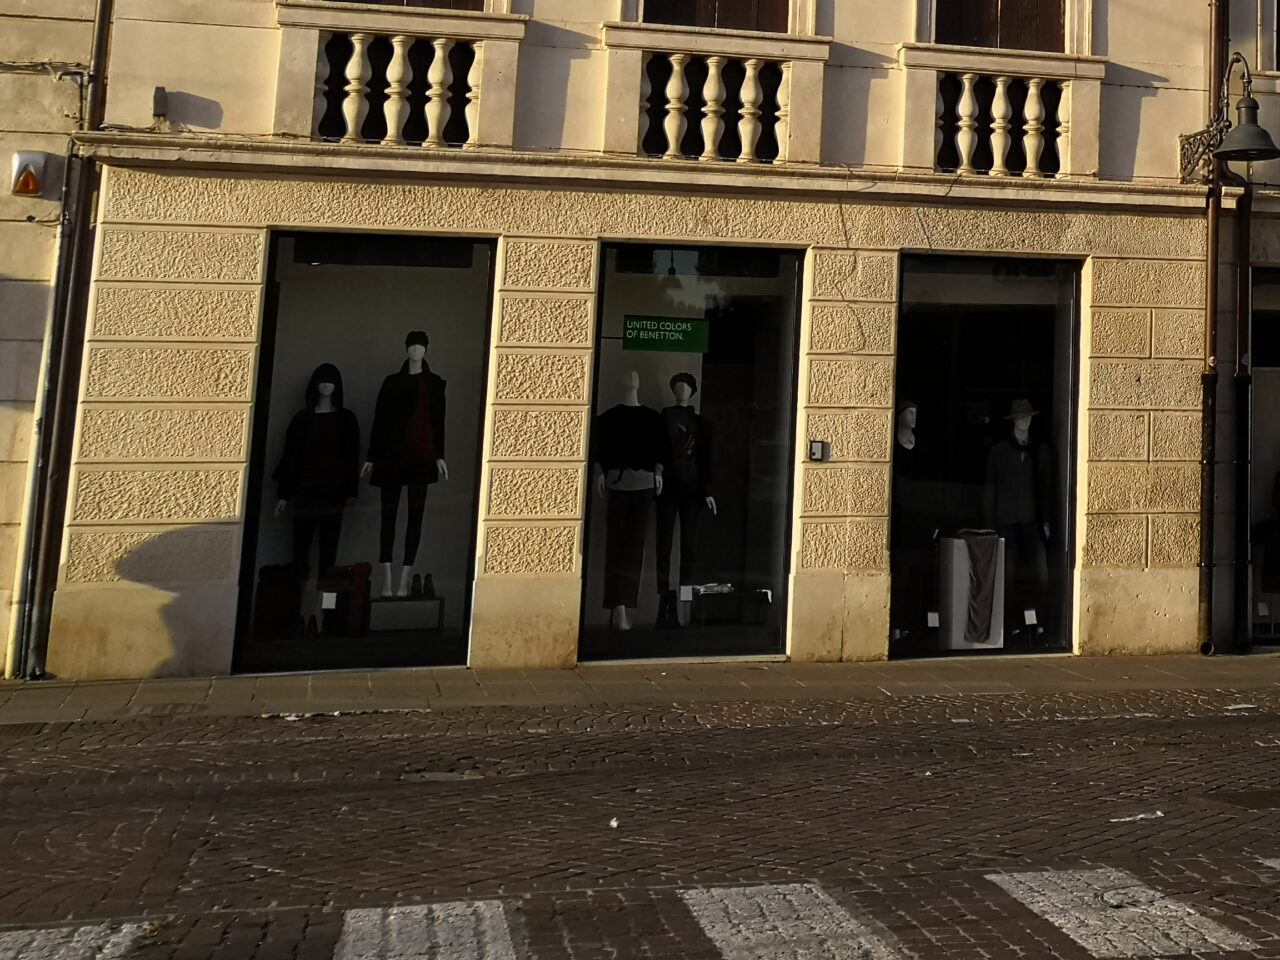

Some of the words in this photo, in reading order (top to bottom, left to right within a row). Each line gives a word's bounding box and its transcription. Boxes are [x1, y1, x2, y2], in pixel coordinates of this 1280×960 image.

[626, 321, 658, 329] UNITED
[659, 322, 692, 331] COLORS
[626, 330, 638, 339] OF
